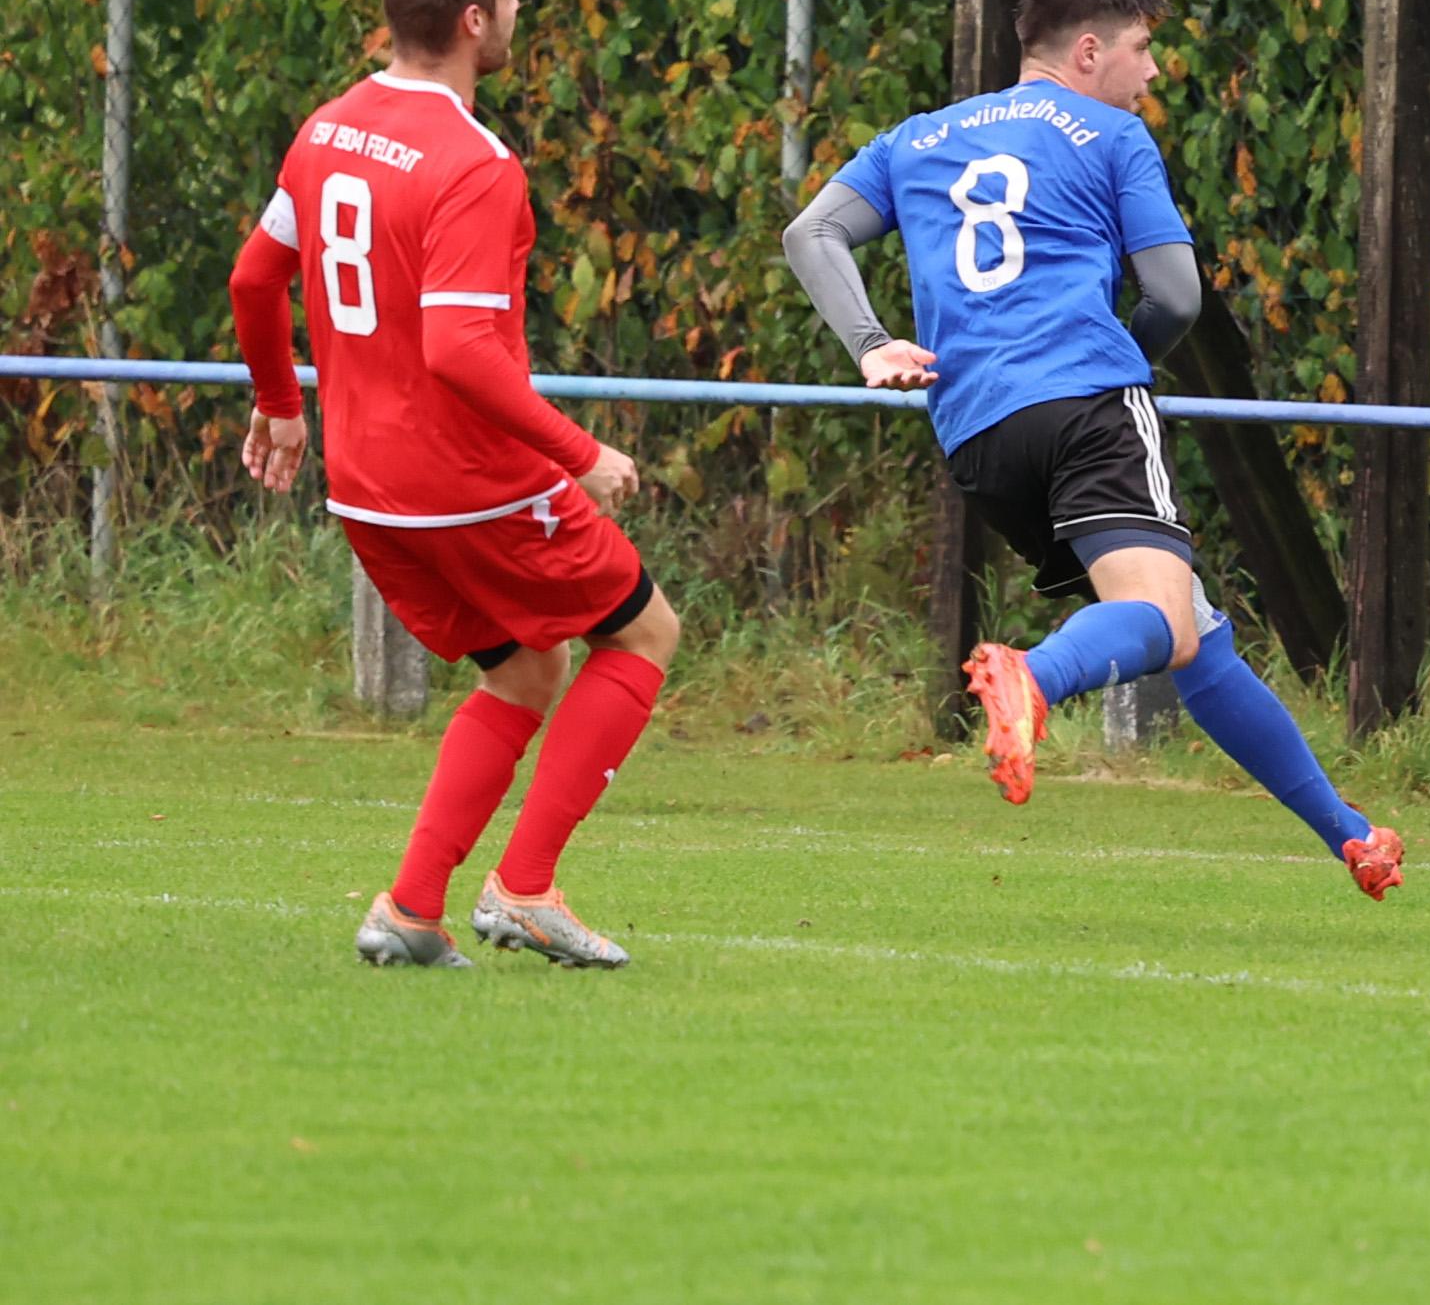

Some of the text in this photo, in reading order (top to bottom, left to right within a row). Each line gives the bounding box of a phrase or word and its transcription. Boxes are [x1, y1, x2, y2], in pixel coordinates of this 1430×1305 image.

[364, 133, 424, 173] FEUCHT
[911, 98, 1100, 151] tsv winkelhaid
[320, 172, 378, 336] 8
[950, 153, 1029, 293] 8
